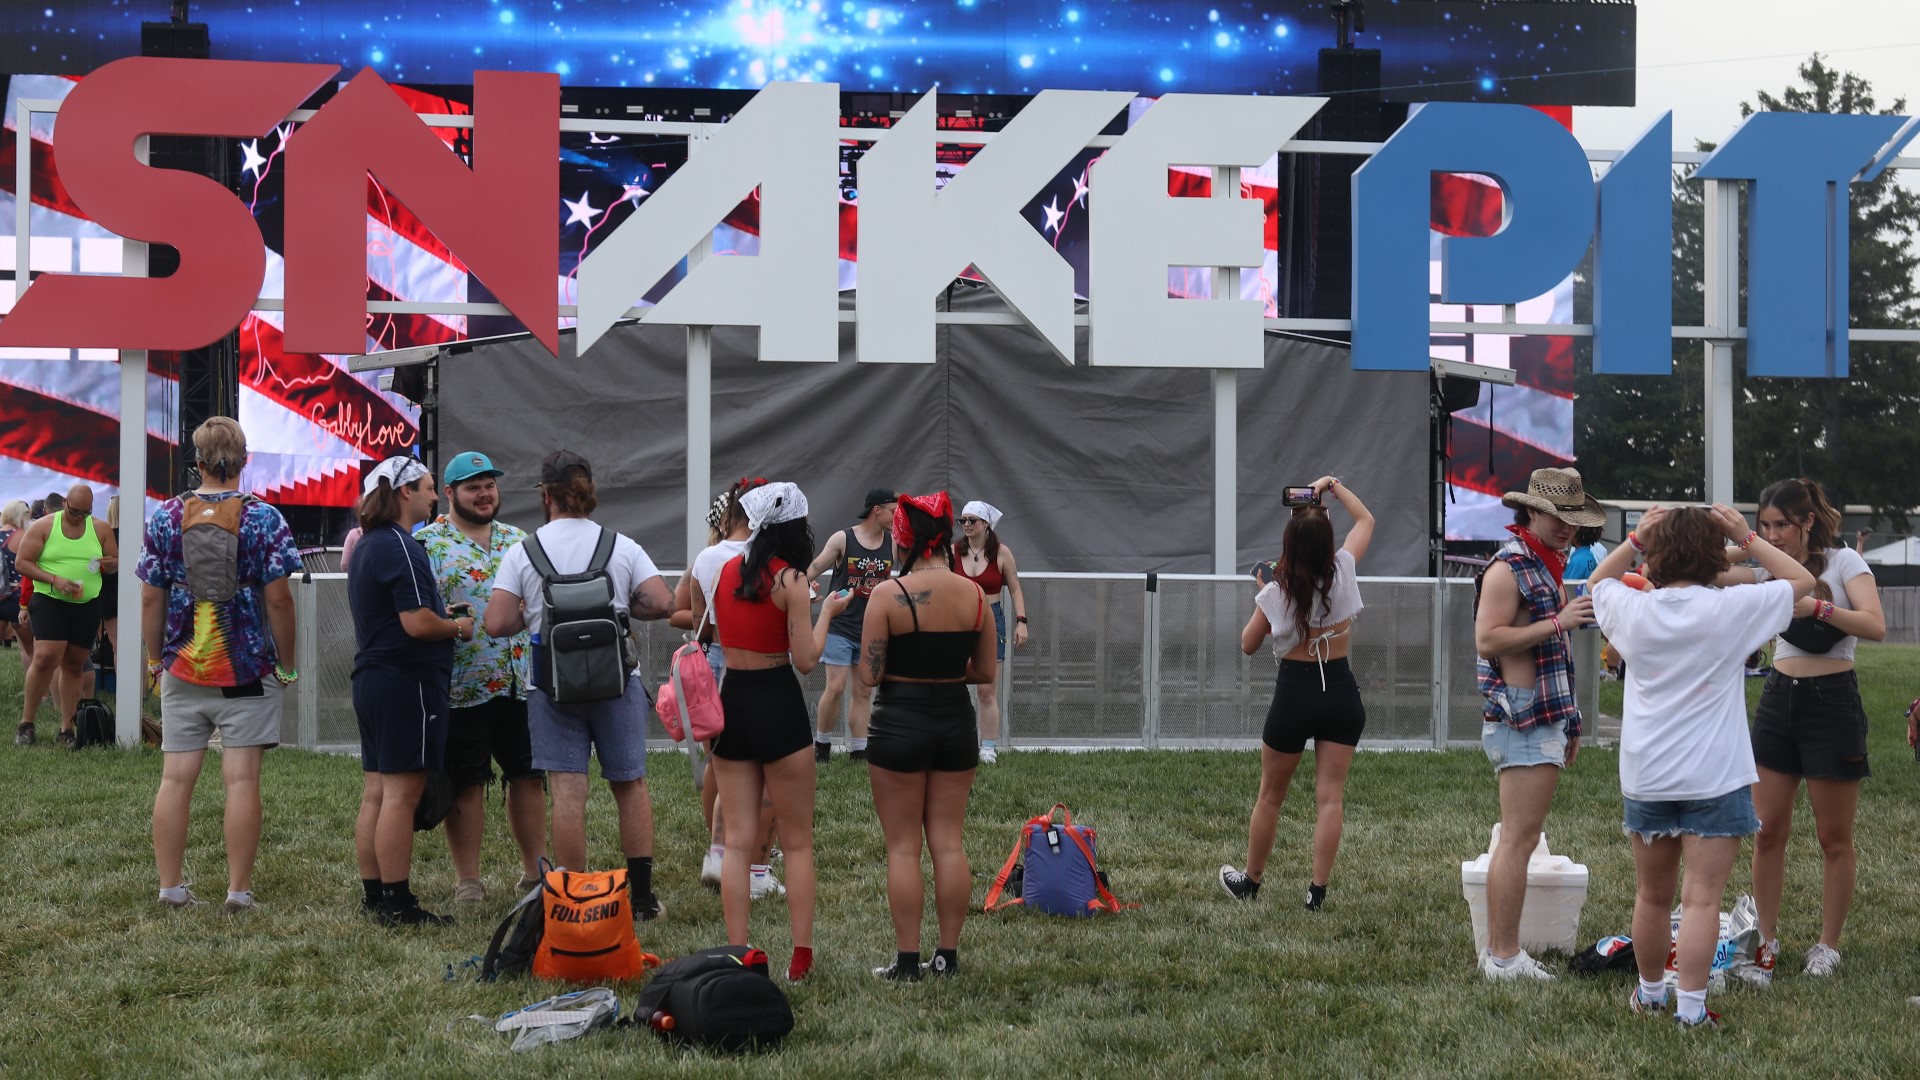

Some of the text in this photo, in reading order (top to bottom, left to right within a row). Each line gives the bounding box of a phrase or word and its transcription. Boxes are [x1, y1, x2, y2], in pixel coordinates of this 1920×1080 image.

[0, 56, 1920, 378] SNAKE PIT
[550, 901, 620, 923] FULL SEND
